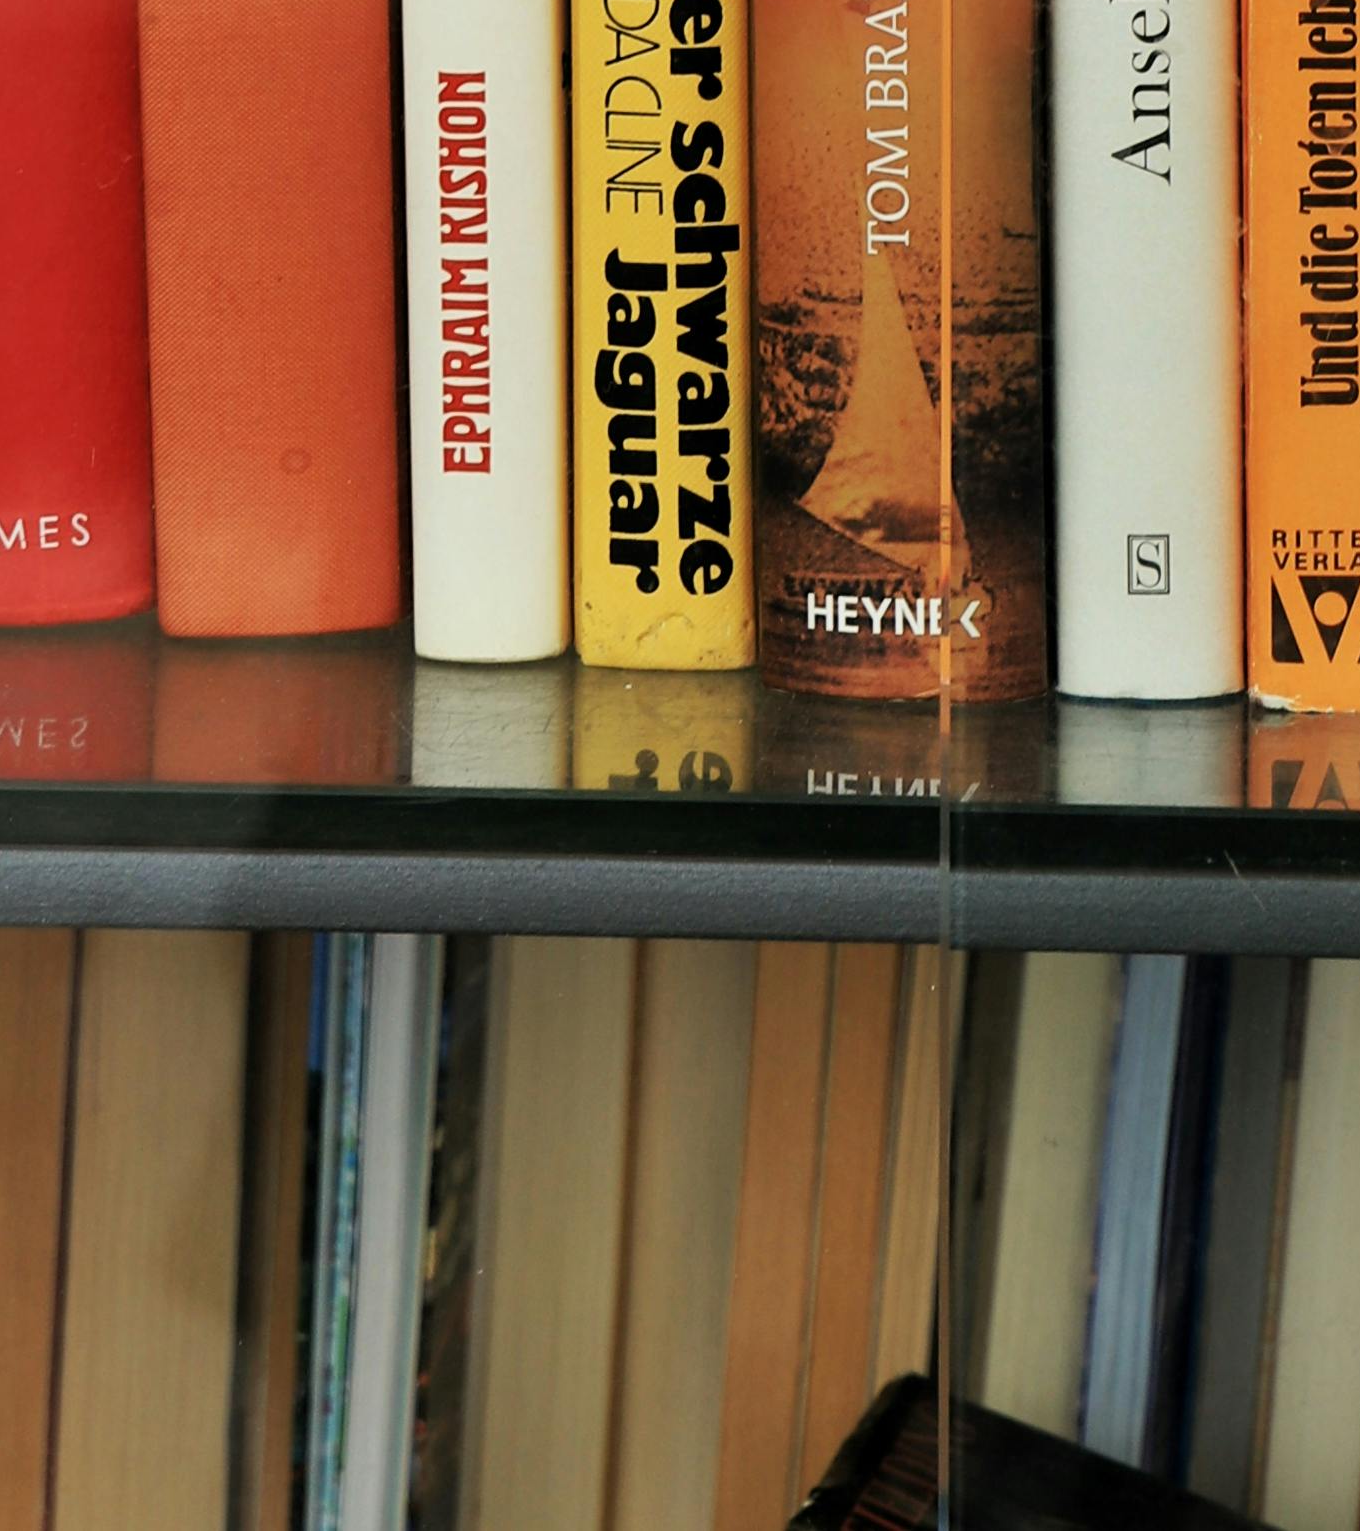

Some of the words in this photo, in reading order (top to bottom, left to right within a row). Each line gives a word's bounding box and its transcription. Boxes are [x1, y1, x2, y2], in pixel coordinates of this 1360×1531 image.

[439, 72, 490, 246] KISHON
[604, 75, 664, 216] CLINE
[865, 127, 911, 255] TOM
[1298, 81, 1358, 219] Toten
[1302, 222, 1359, 316] die
[441, 257, 491, 474] EPHRAIM
[595, 248, 669, 594] Jaguar
[669, 122, 740, 597] schwarze
[1300, 325, 1359, 408] Und
